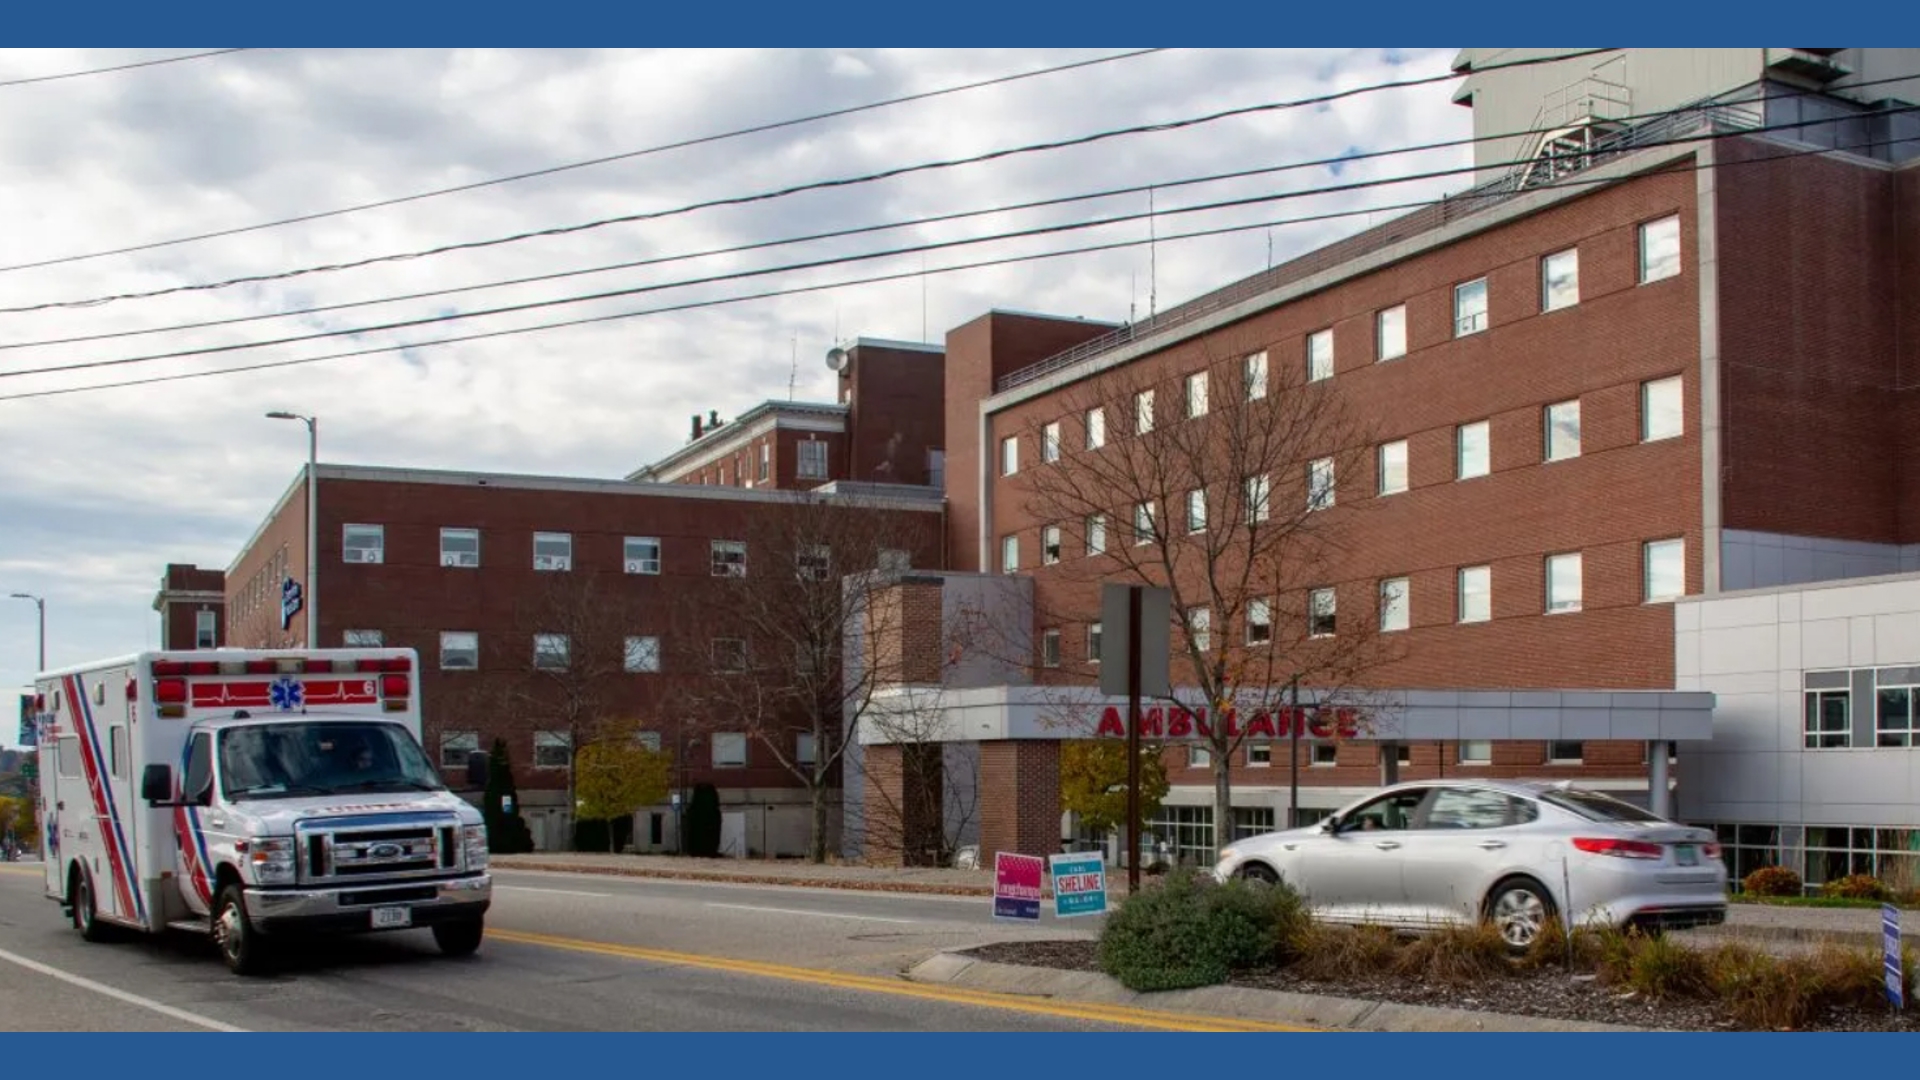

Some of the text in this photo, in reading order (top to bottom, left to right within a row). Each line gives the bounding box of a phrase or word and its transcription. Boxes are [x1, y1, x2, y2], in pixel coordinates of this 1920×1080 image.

[363, 680, 374, 695] 6
[1097, 706, 1357, 737] AMBULANCE
[1058, 873, 1101, 893] SHELINE
